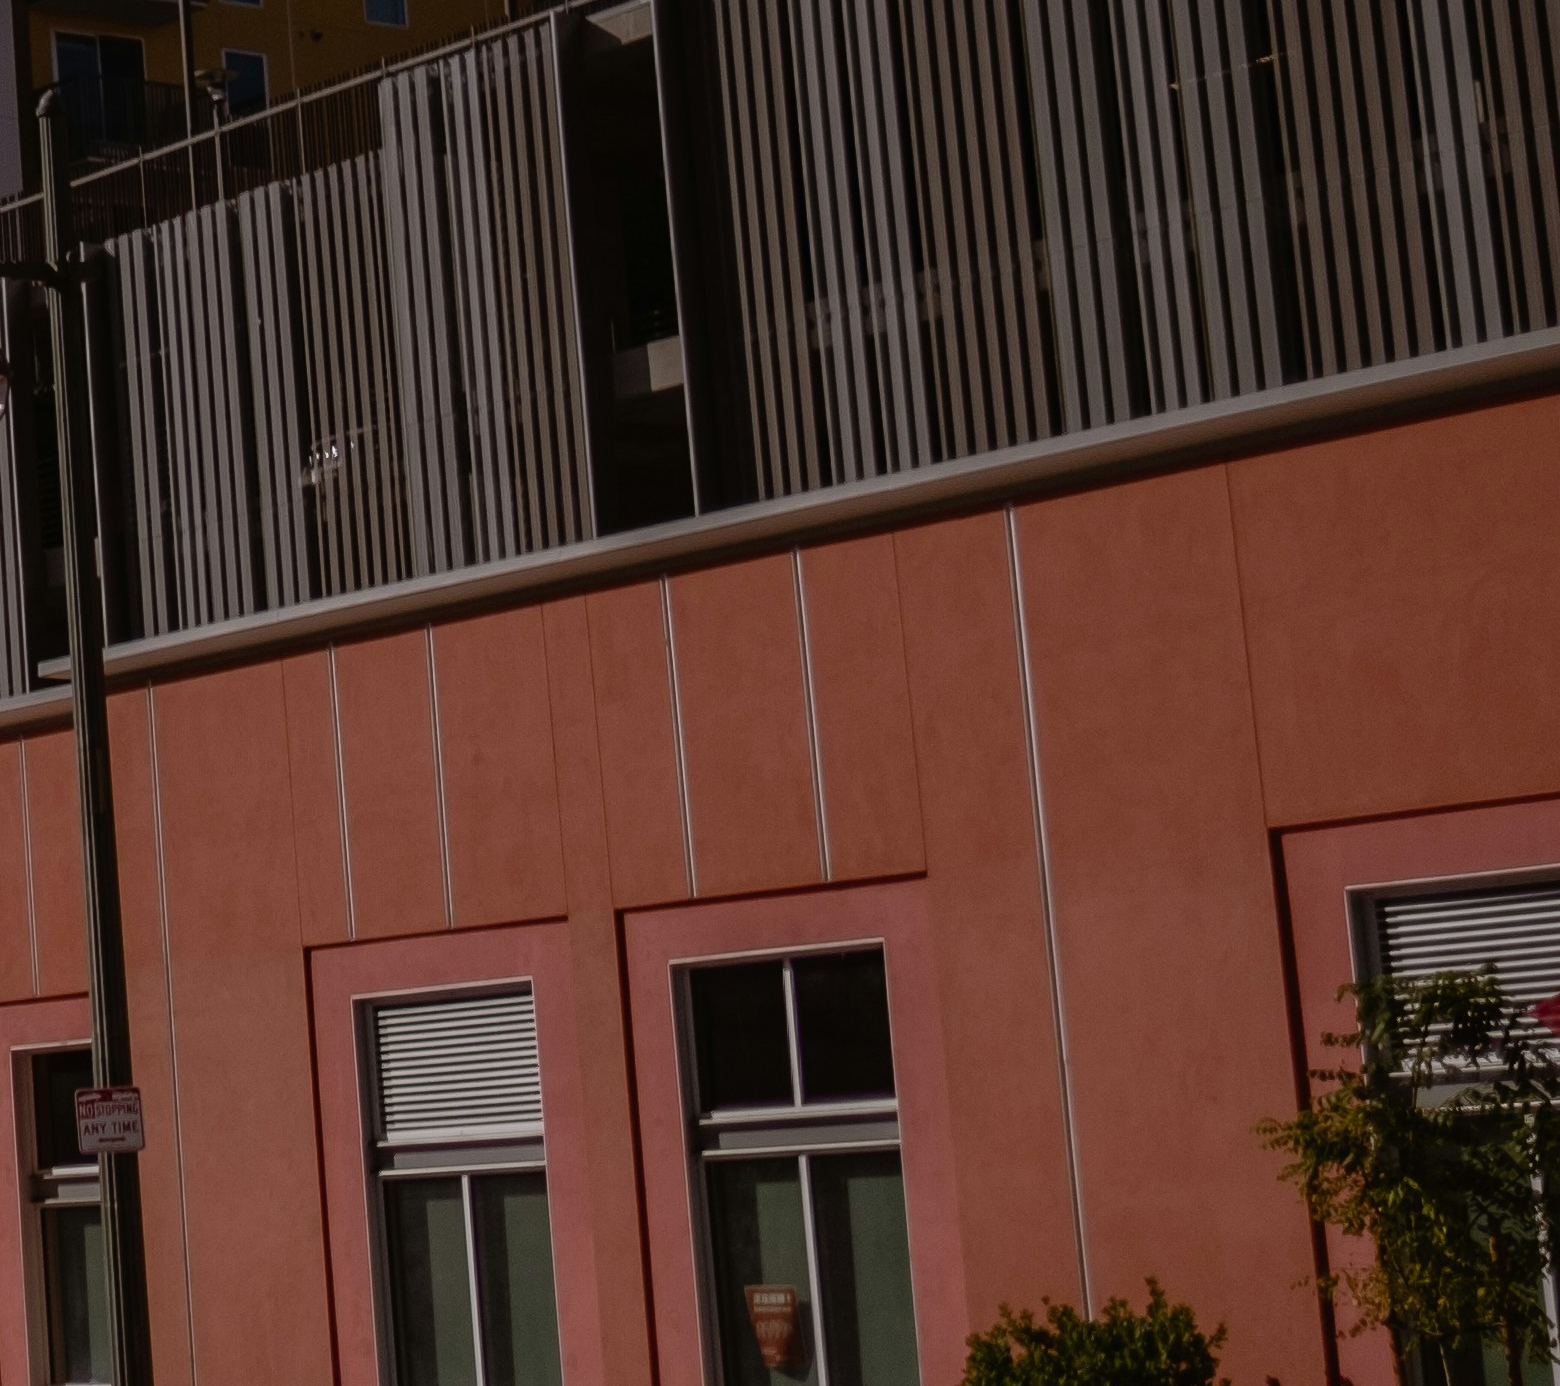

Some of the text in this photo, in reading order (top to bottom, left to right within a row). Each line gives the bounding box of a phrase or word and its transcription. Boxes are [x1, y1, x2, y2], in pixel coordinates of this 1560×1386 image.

[79, 1102, 139, 1118] NO STOPPING
[84, 1121, 139, 1136] ANY TIME
